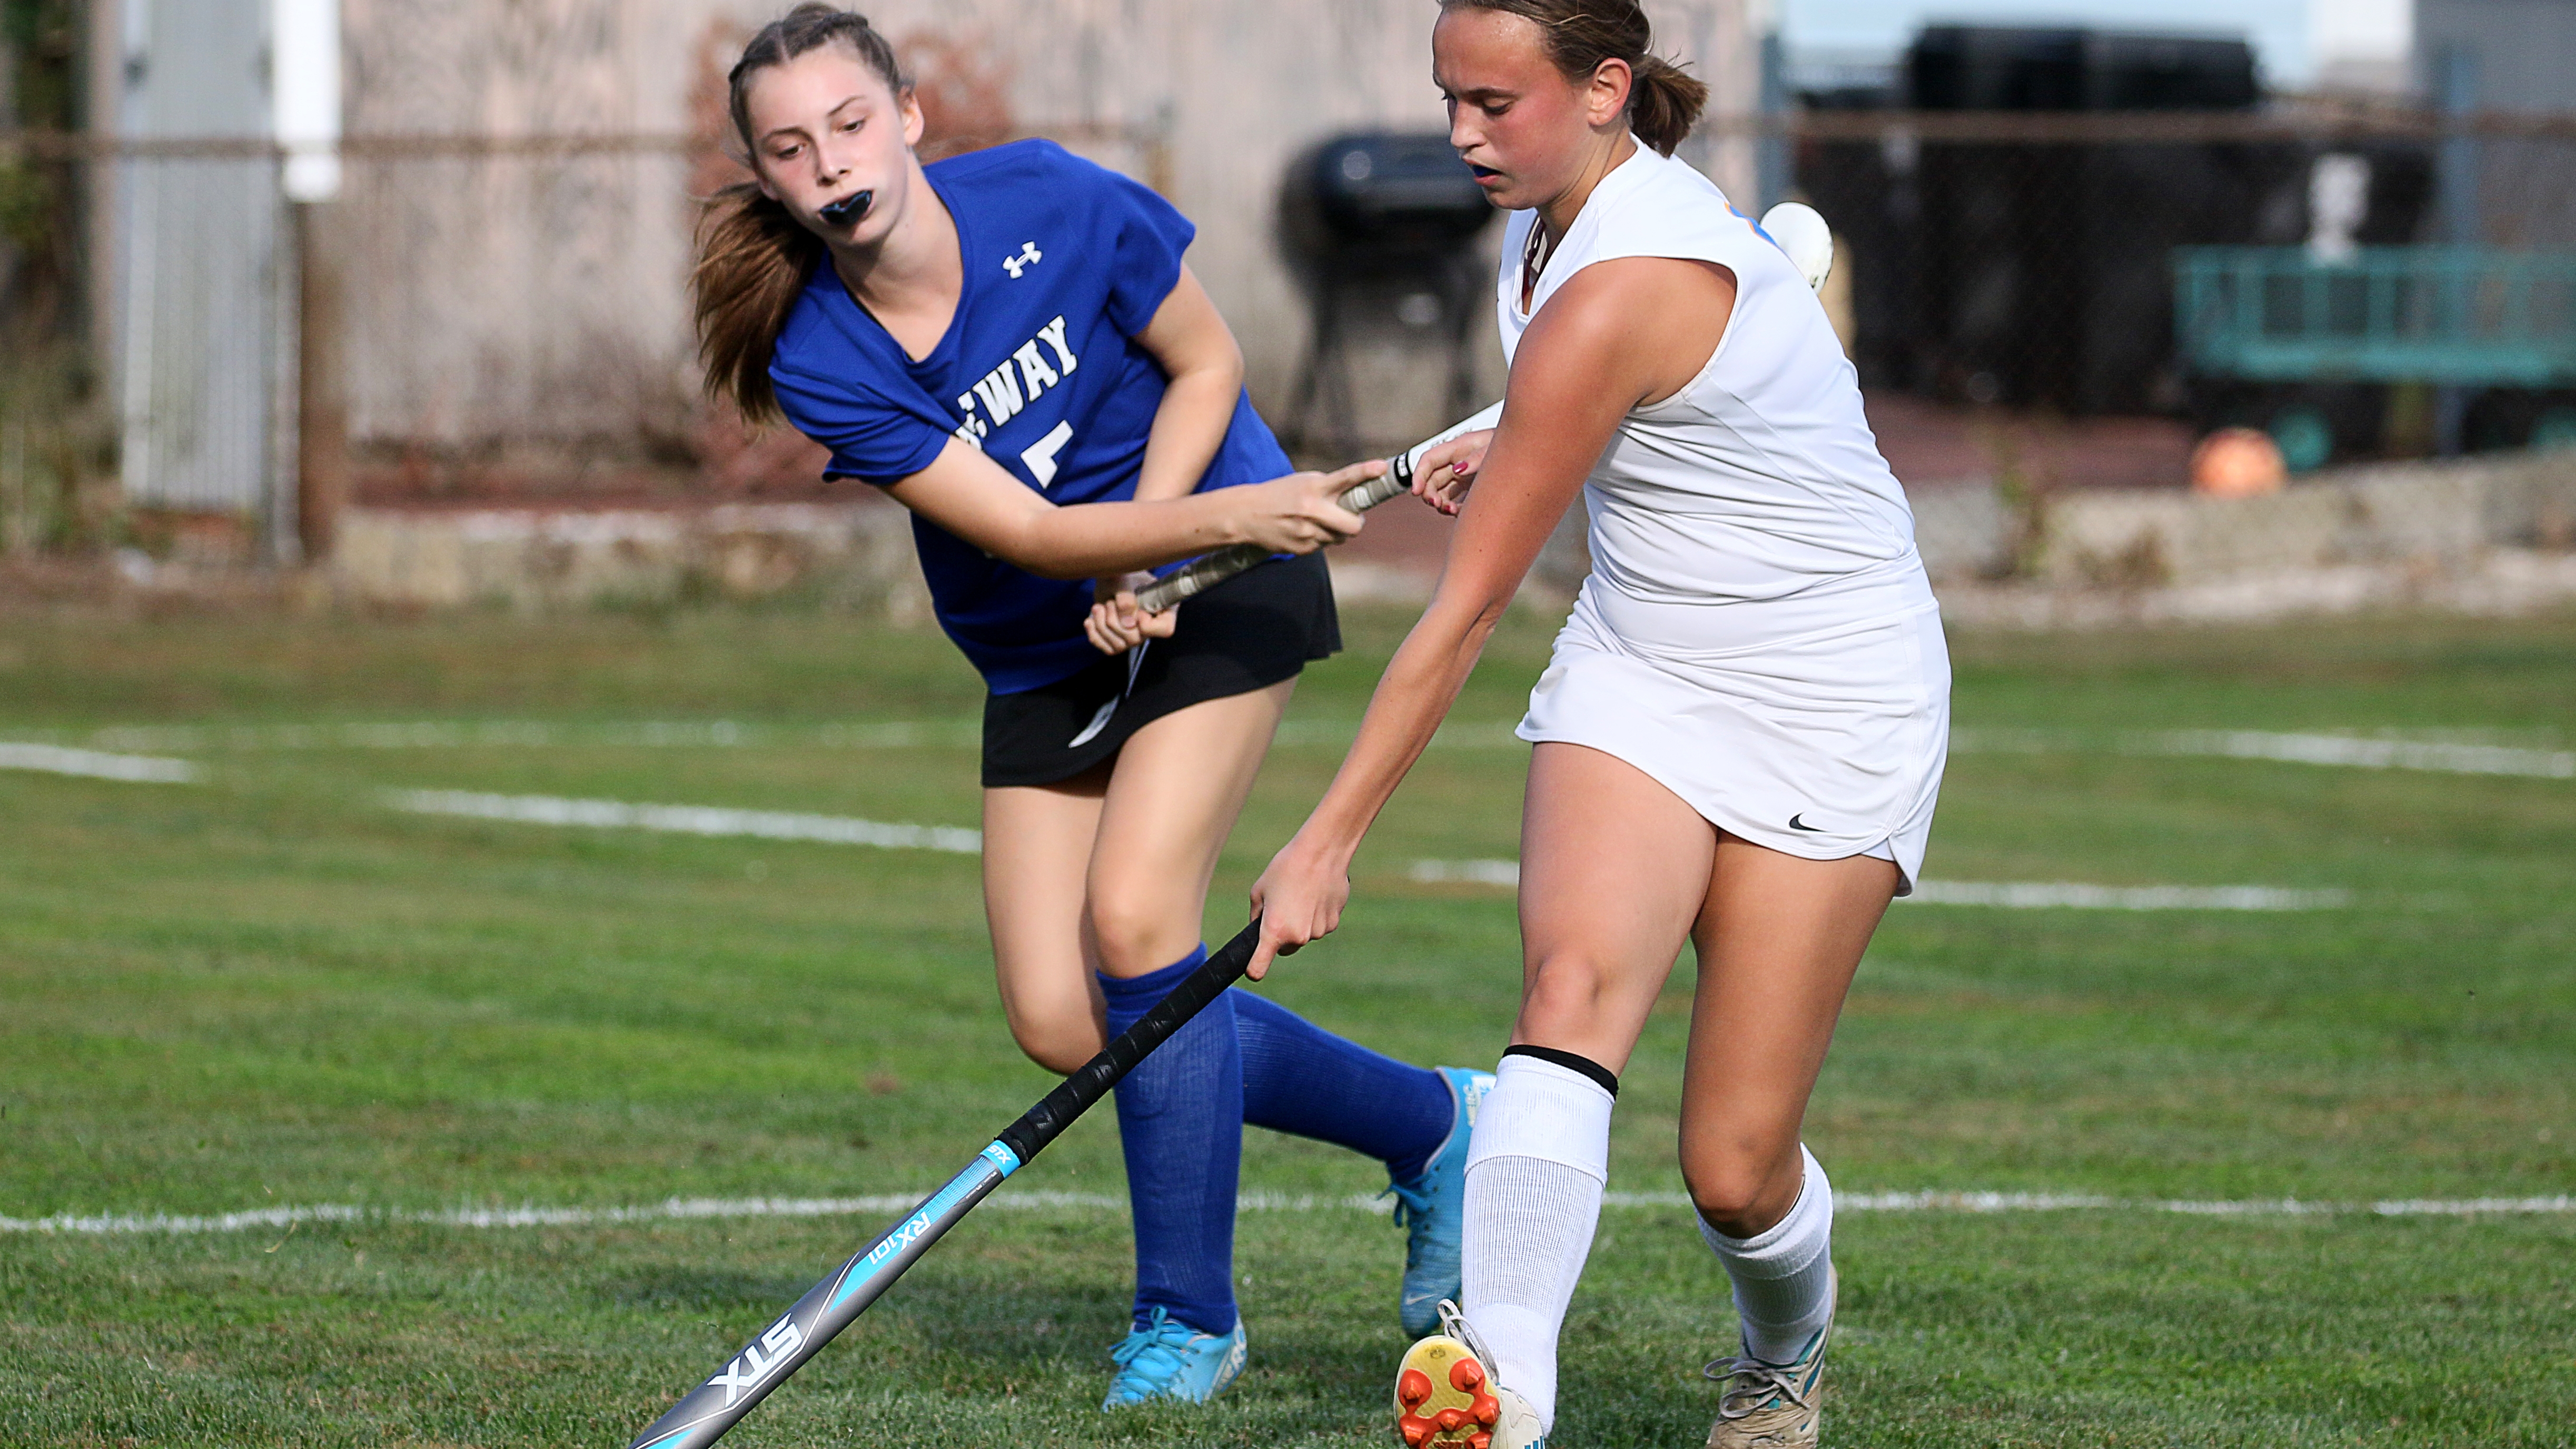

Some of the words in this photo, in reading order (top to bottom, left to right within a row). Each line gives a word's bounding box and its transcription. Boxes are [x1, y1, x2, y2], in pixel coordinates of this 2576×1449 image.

[987, 1144, 1012, 1165] STX
[868, 1211, 932, 1265] RX101
[706, 1313, 802, 1408] STX
